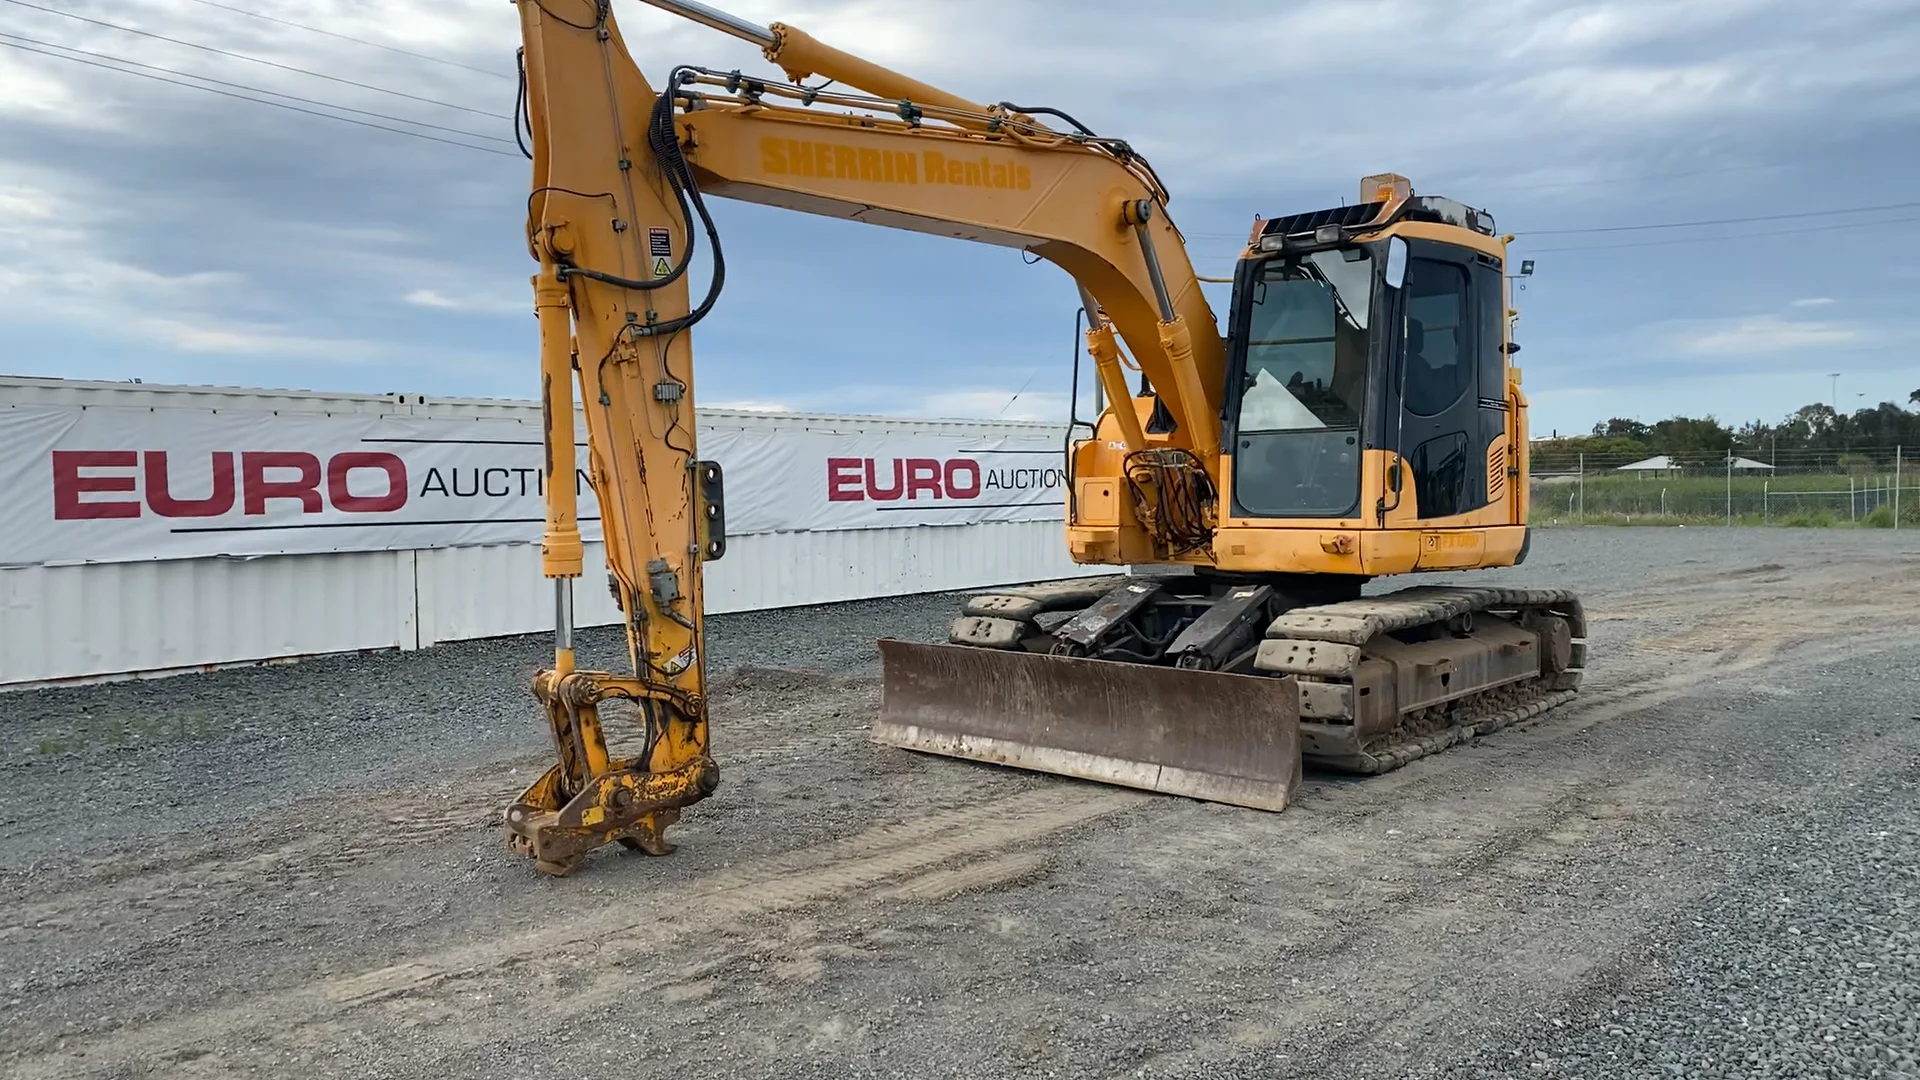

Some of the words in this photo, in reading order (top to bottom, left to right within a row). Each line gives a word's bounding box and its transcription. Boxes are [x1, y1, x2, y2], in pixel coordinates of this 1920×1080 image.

[759, 136, 918, 184] SHERRIN
[923, 150, 1032, 190] Rentals
[52, 450, 408, 520] EURO
[420, 467, 595, 498] AUCTIN
[828, 458, 981, 501] EURO
